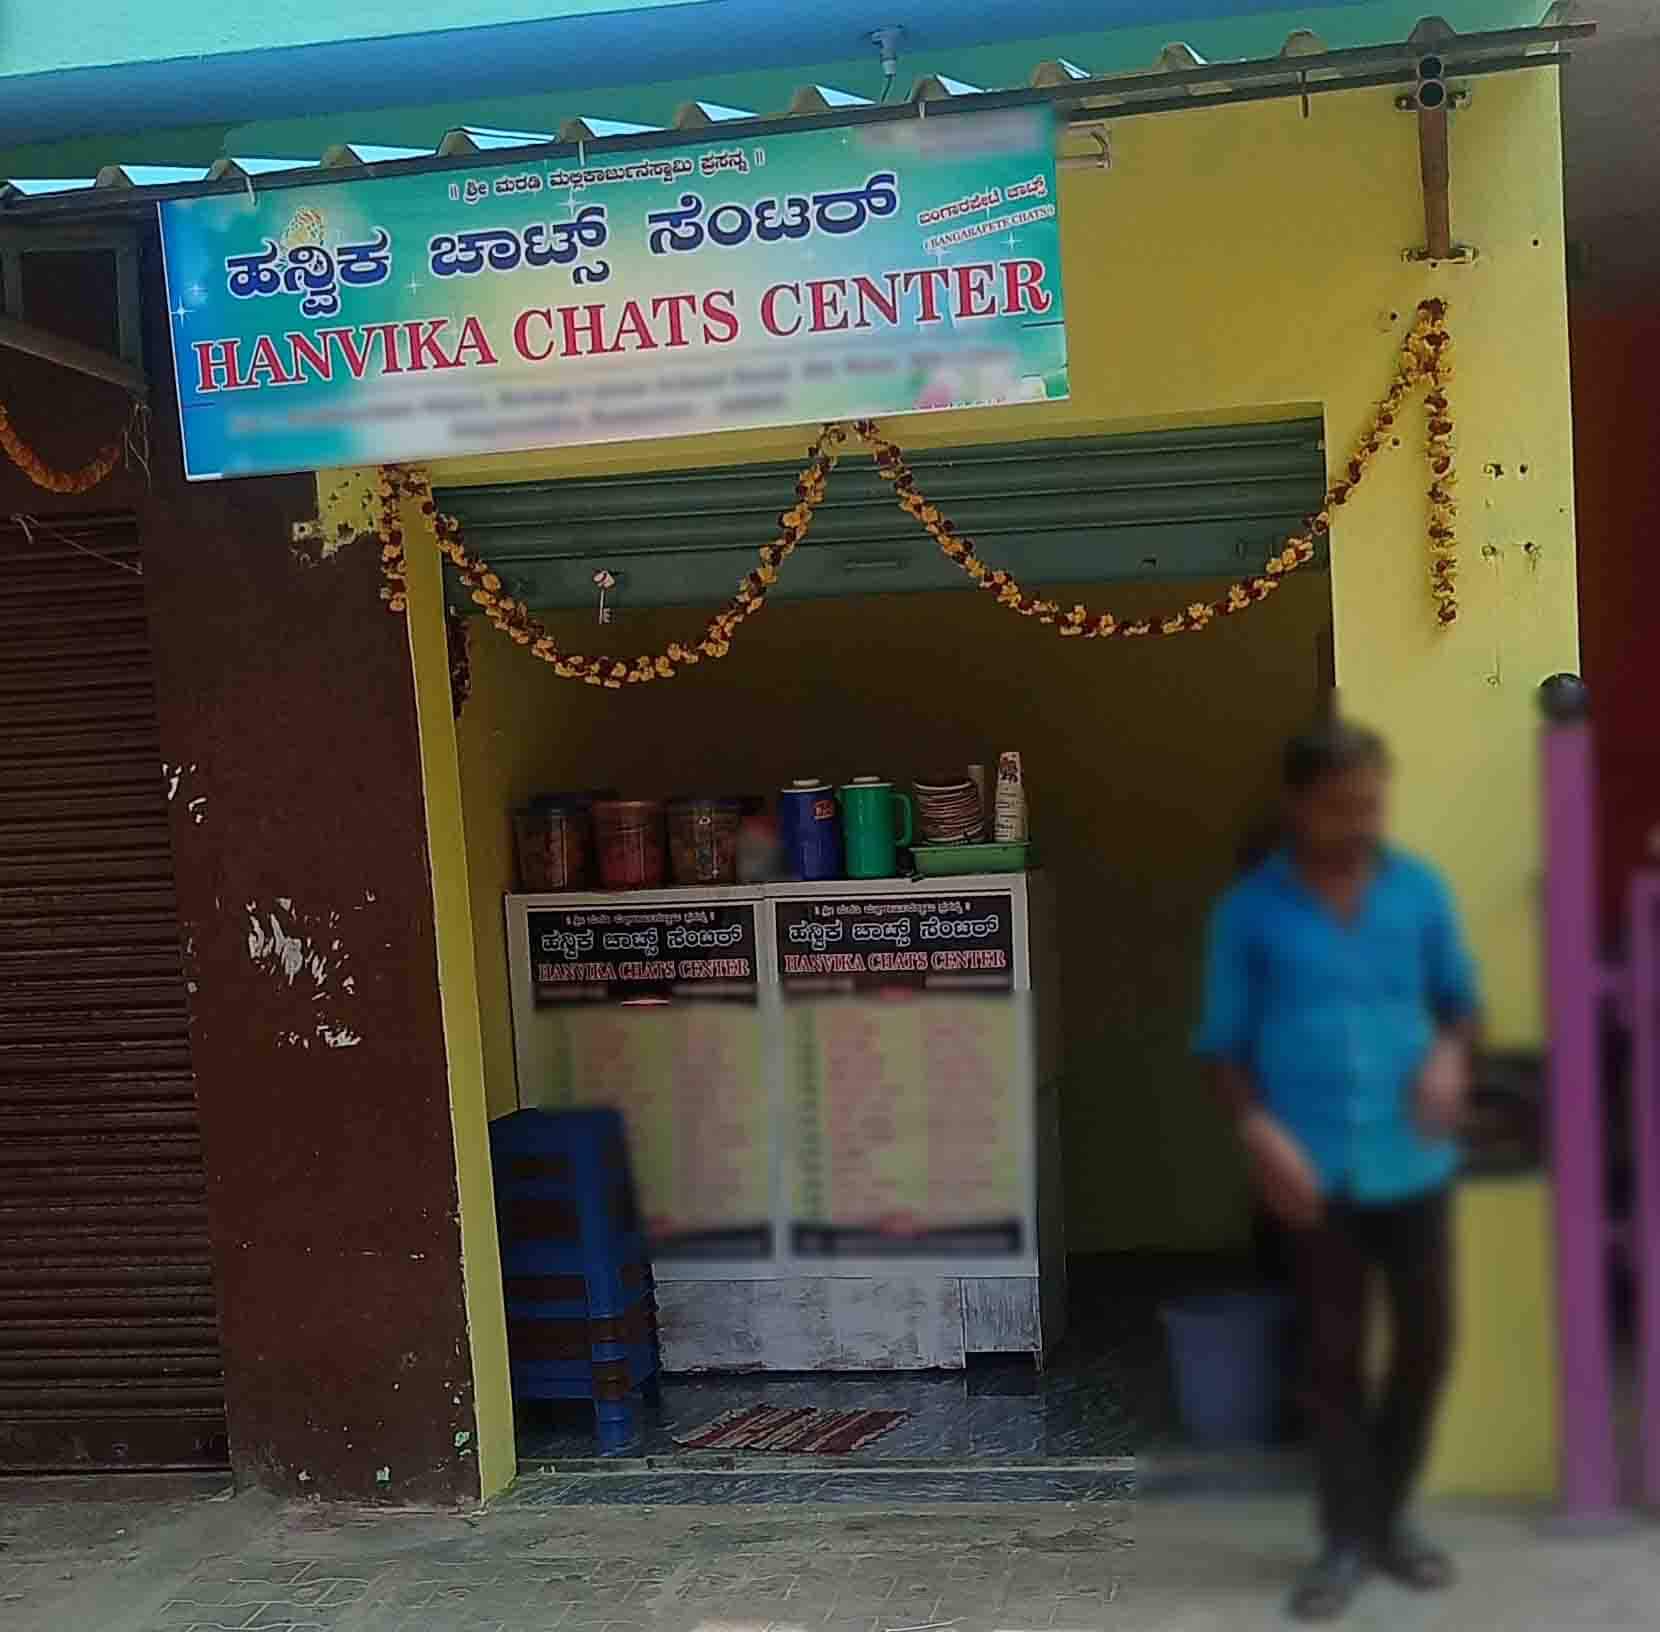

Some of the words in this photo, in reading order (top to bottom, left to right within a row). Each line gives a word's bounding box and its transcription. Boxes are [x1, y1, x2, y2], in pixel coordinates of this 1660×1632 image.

[465, 181, 488, 205] ಶ್ರೀ
[495, 173, 543, 194] ಮರಡಿ
[700, 149, 749, 176] ಪ್ರಸನ್ನ
[226, 227, 391, 318] ಹನ್ವಿಕ
[429, 205, 611, 285] ಚಾಟ್ಸ್
[648, 172, 897, 255] ಸೆಂಟರ್
[193, 316, 497, 393] HANVIKA
[513, 289, 740, 361] CHATS
[760, 258, 1053, 338] CENTER
[539, 962, 617, 982] HANVIKA
[619, 960, 676, 980] CHATS
[678, 958, 751, 978] CENTER
[784, 953, 866, 974] HANVIKA
[867, 951, 929, 971] CHATS
[931, 949, 1007, 970] CENTER
